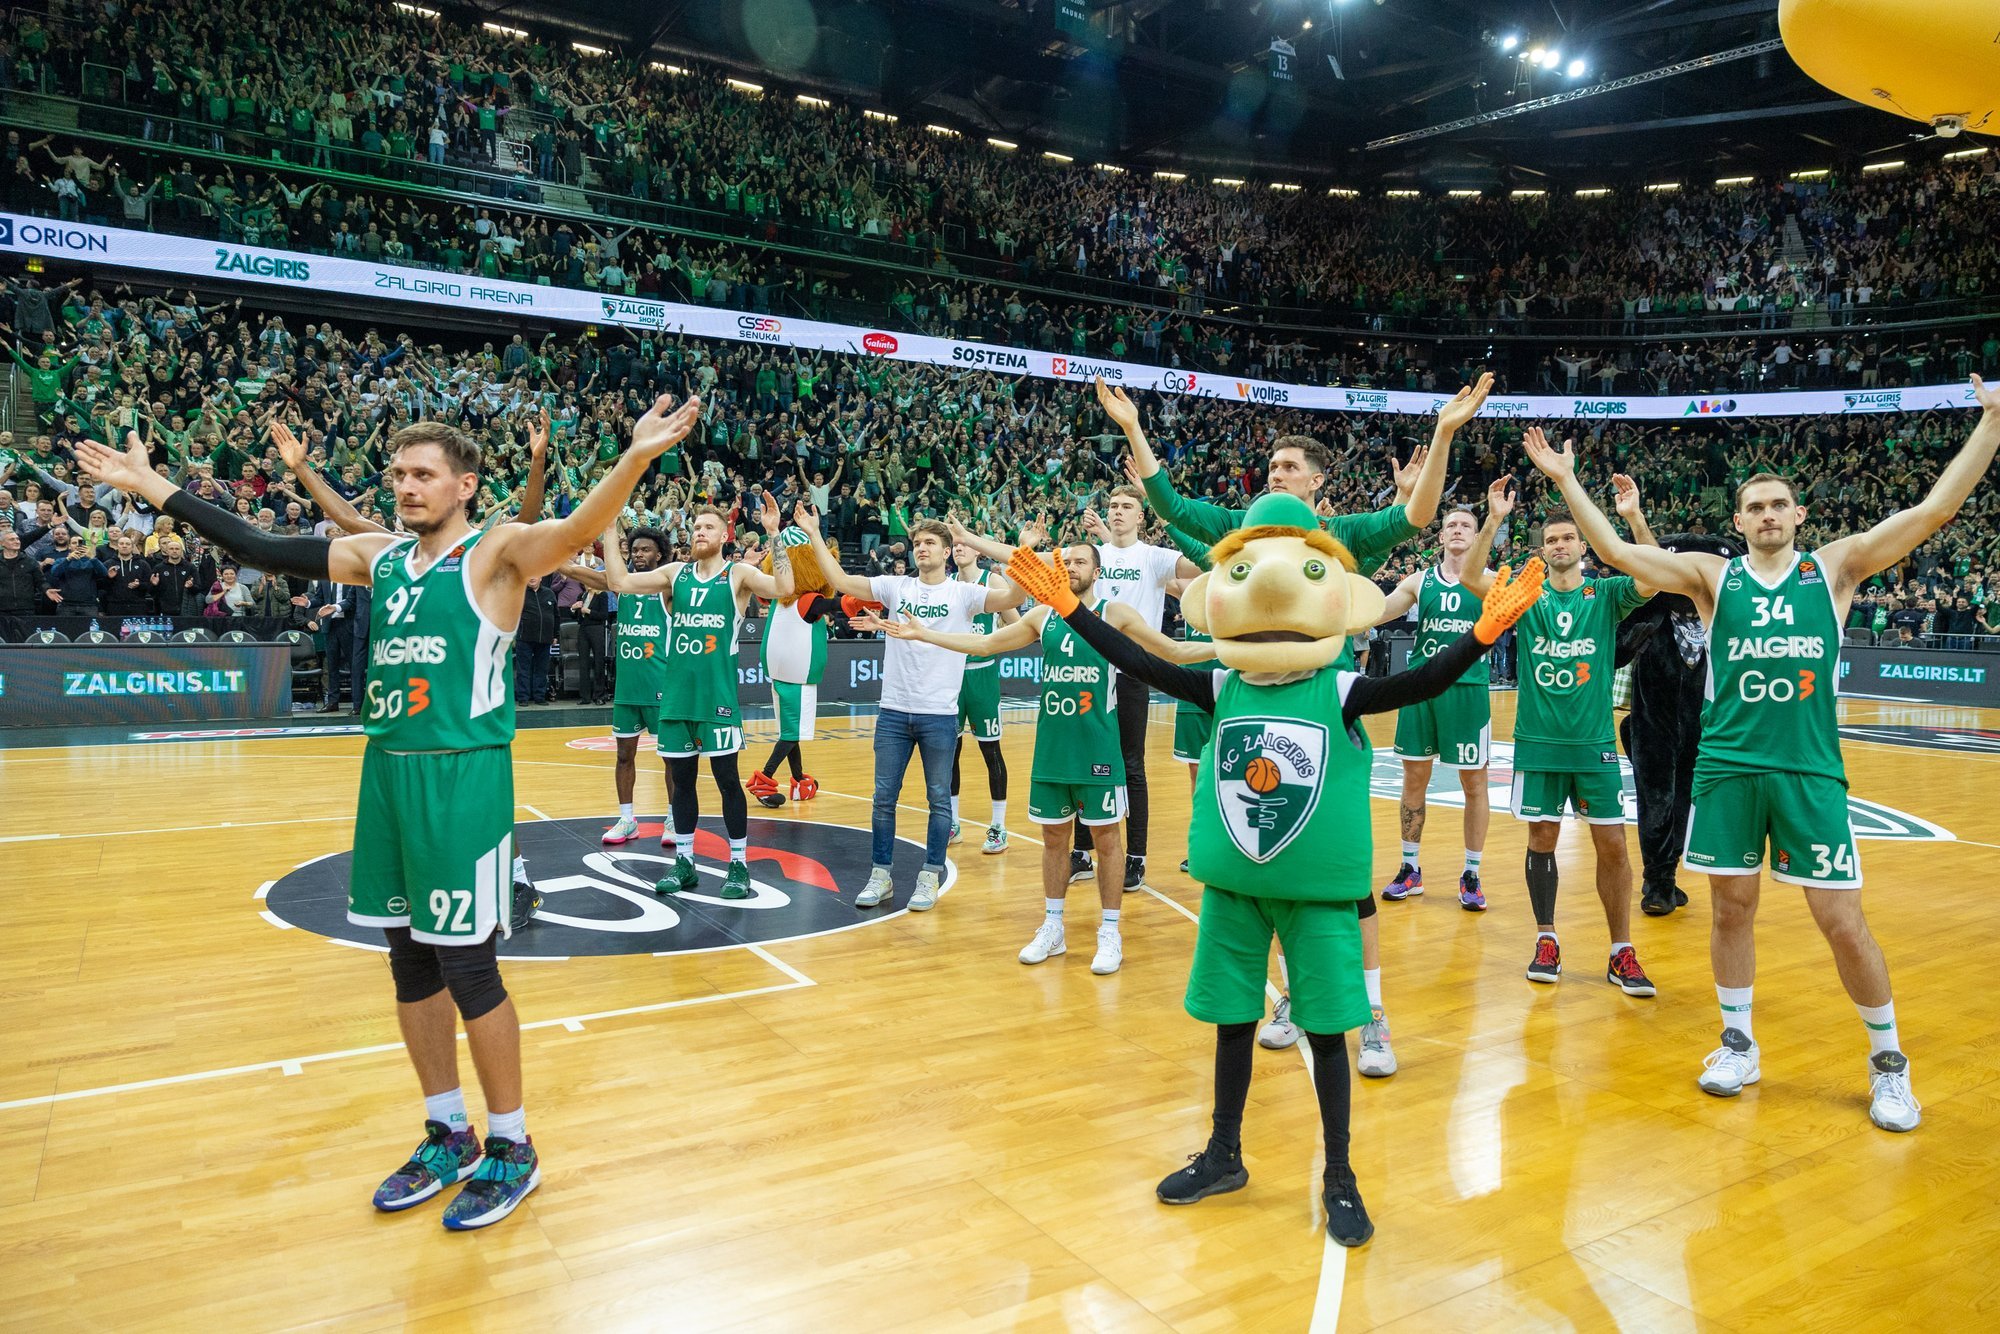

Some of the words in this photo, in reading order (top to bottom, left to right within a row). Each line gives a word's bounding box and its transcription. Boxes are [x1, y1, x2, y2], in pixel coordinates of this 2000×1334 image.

[1278, 54, 1288, 71] 13
[20, 224, 108, 252] ORION
[215, 249, 310, 281] ŽALGIRIS
[470, 287, 533, 306] ARENA
[619, 300, 665, 318] ŽALGIRIS
[739, 330, 780, 342] SENUKAI
[866, 337, 895, 350] Galinta
[952, 346, 1028, 369] SOSTENA
[1252, 386, 1288, 403] voltas
[1356, 392, 1388, 403] ŽALGIRIS
[1858, 393, 1901, 403] ŽALGIRIS
[1487, 403, 1529, 411] ARENA
[1574, 400, 1627, 415] ŽALGIRIS
[386, 586, 424, 625] 92
[689, 587, 709, 607] 17
[1440, 592, 1461, 612] 10
[634, 602, 643, 619] 2
[674, 611, 725, 629] ŽALGIRIS
[1751, 595, 1795, 627] 34
[618, 622, 660, 637] ŽALGIRIS
[1556, 611, 1574, 637] 9
[620, 641, 655, 660] Go3
[676, 633, 717, 655] Go3
[1060, 633, 1074, 657] 4
[1532, 636, 1597, 659] ŽALGIRIS
[1727, 635, 1825, 662] ŽALGIRIS
[66, 670, 243, 695] ZALGIRIS.LT
[1534, 661, 1591, 688] Go3
[1880, 664, 1985, 683] ZALGIRIS.LT
[1739, 669, 1816, 703] Go3
[1045, 690, 1093, 716] Go3
[983, 717, 999, 736] 16
[713, 726, 732, 749] 17
[1222, 748, 1240, 773] BC
[1243, 732, 1316, 779] ŽALGIRIS
[1457, 743, 1478, 764] 10
[1102, 791, 1116, 815] 4
[1811, 843, 1854, 879] 34
[429, 889, 472, 932] 92
